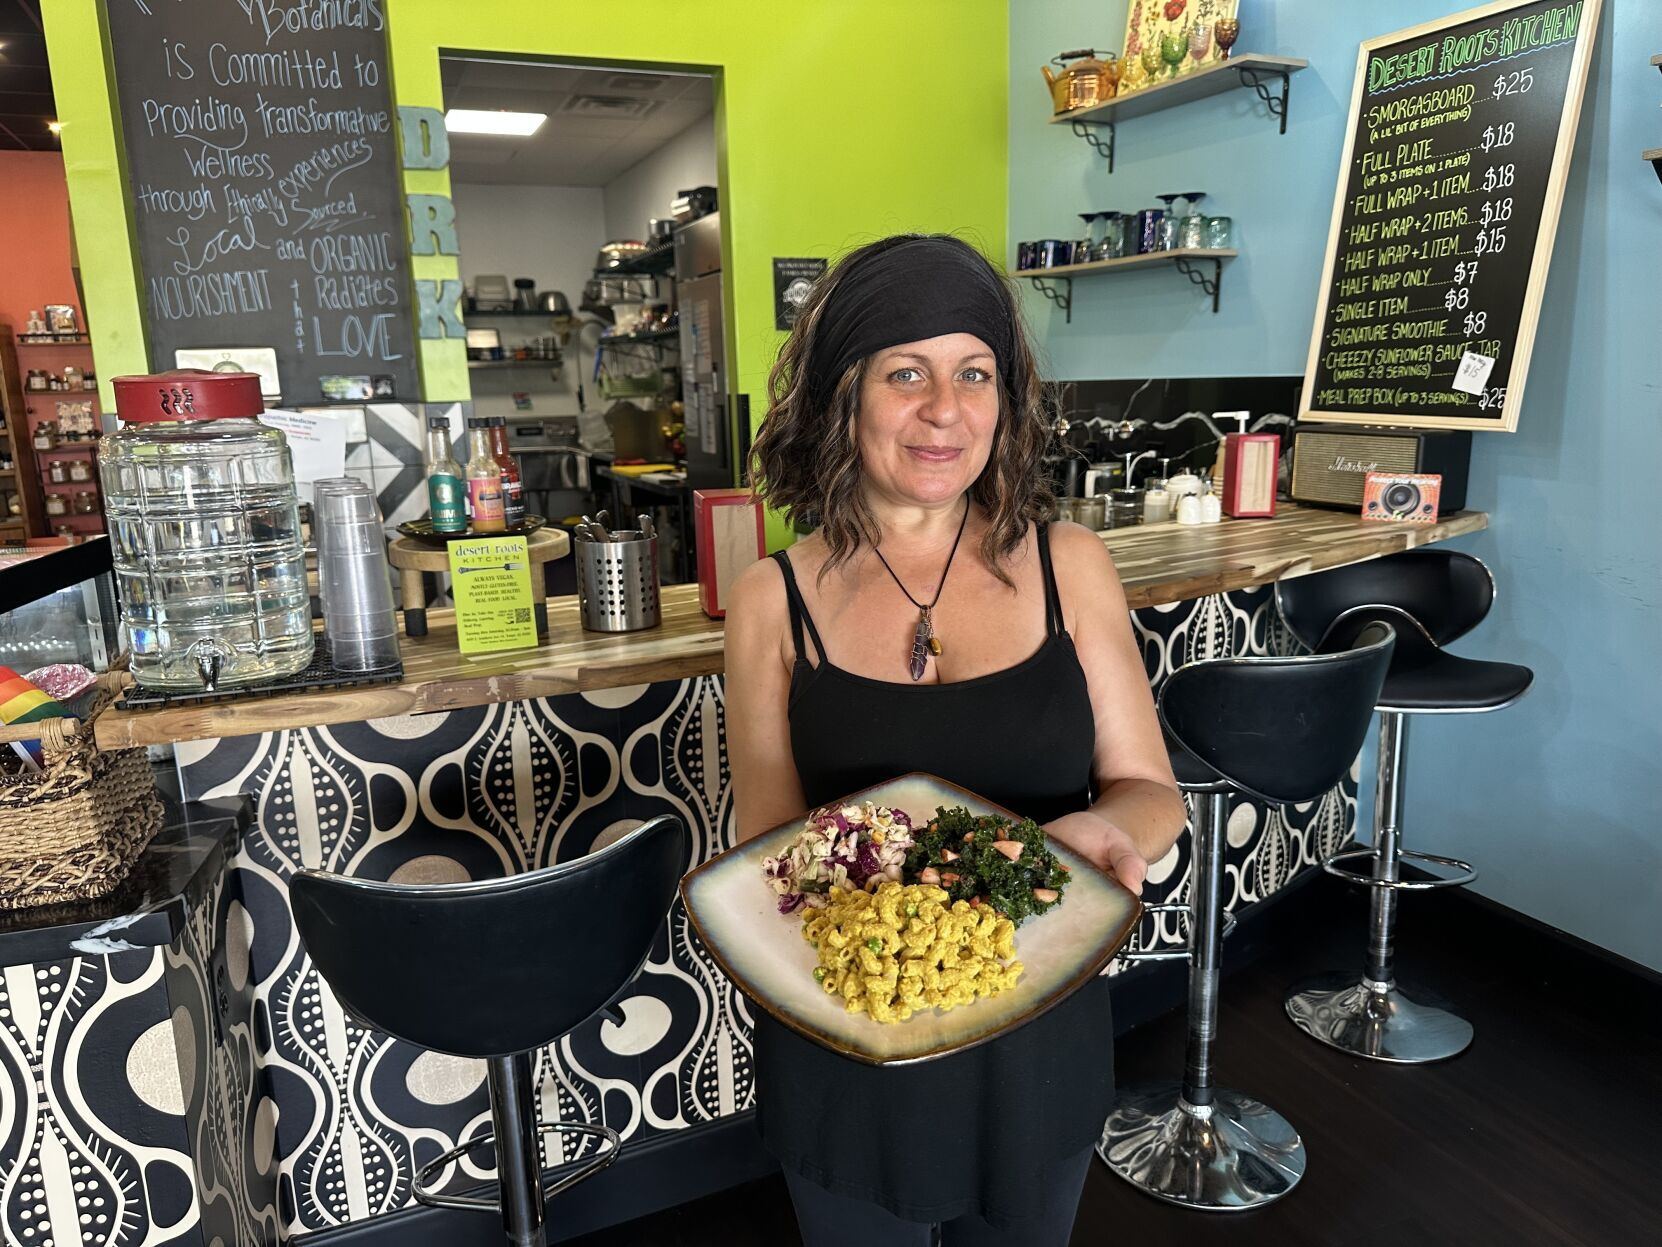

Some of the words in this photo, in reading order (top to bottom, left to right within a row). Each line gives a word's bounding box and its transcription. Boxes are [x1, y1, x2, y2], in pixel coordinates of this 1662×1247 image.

[163, 38, 194, 80] is
[209, 43, 342, 89] Committed
[355, 54, 379, 87] to
[1369, 43, 1439, 92] DESERT
[1440, 29, 1499, 73] ROOTS
[1500, 1, 1583, 56] KITCHEN
[1367, 84, 1475, 128] SMORGASBOARD
[1492, 67, 1534, 100] $25
[143, 96, 247, 150] Providing
[256, 93, 390, 138] transformative
[1396, 122, 1409, 135] BIT
[1409, 119, 1420, 131] OF
[184, 145, 274, 181] Wellness
[278, 137, 373, 197] experiences
[1362, 152, 1392, 175] FULL
[1396, 139, 1434, 166] PLATE
[1481, 122, 1515, 153] $18
[1354, 194, 1383, 216] FULL
[1387, 184, 1422, 210] WRAP
[1441, 172, 1470, 198] ITEM
[1483, 164, 1515, 192] $18
[1390, 171, 1397, 181] 3
[1399, 166, 1423, 179] ITEMS
[1424, 163, 1436, 173] ON
[1438, 162, 1444, 171] 1
[139, 183, 216, 220] through
[224, 183, 288, 226] Ethically
[1350, 222, 1380, 245] HALF
[1381, 216, 1414, 239] WRAP
[1433, 206, 1468, 231] ITEMS
[1480, 198, 1513, 228] $18
[167, 216, 270, 275] Local
[277, 238, 306, 260] and
[310, 232, 397, 273] ORGANIC
[1344, 249, 1375, 272] HALF
[1377, 245, 1410, 267] WRAP
[1430, 234, 1460, 258] ITEM
[1475, 226, 1506, 257] $15
[151, 270, 272, 320] NOURISHMENT
[314, 275, 398, 310] Radiates
[1340, 275, 1369, 297] HALF
[1372, 272, 1400, 292] WRAP
[1402, 268, 1432, 288] ONLY
[1454, 261, 1478, 285] $7
[1335, 301, 1377, 322] SINGLE
[1379, 296, 1408, 317] ITEM
[1445, 287, 1469, 311] $8
[313, 313, 401, 361] LOVE
[1330, 323, 1389, 347] SIGNATURE
[1392, 319, 1448, 340] SMOOTHIE
[1463, 311, 1487, 337] $8
[1375, 344, 1434, 365] SUNFLOWER
[1319, 388, 1345, 405] MEAL
[1348, 387, 1372, 405] PREP
[1373, 388, 1395, 405] BOX
[1419, 392, 1428, 405] 3
[1478, 386, 1506, 410] $25
[456, 545, 489, 556] desert
[495, 543, 524, 554] roots
[463, 554, 520, 563] KITCHEN
